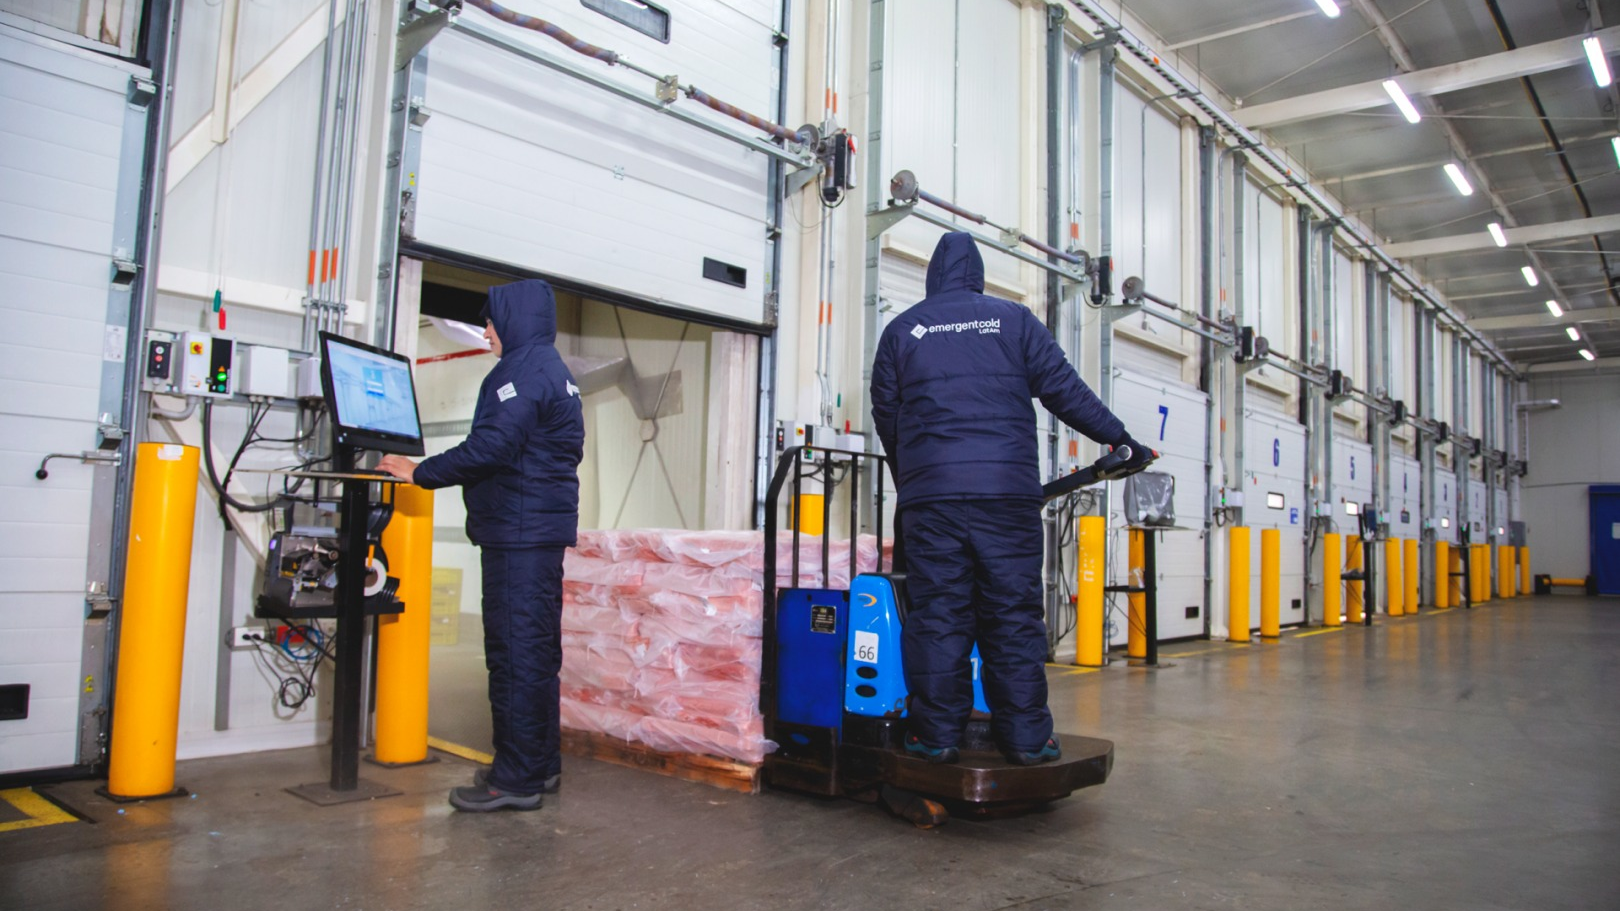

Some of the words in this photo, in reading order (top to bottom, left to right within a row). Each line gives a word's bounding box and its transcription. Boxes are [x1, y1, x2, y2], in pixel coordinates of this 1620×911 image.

[928, 318, 1000, 333] emergentcold
[1158, 404, 1169, 441] 7
[1273, 438, 1280, 467] 6
[1350, 456, 1355, 480] 5
[858, 645, 875, 661] 66
